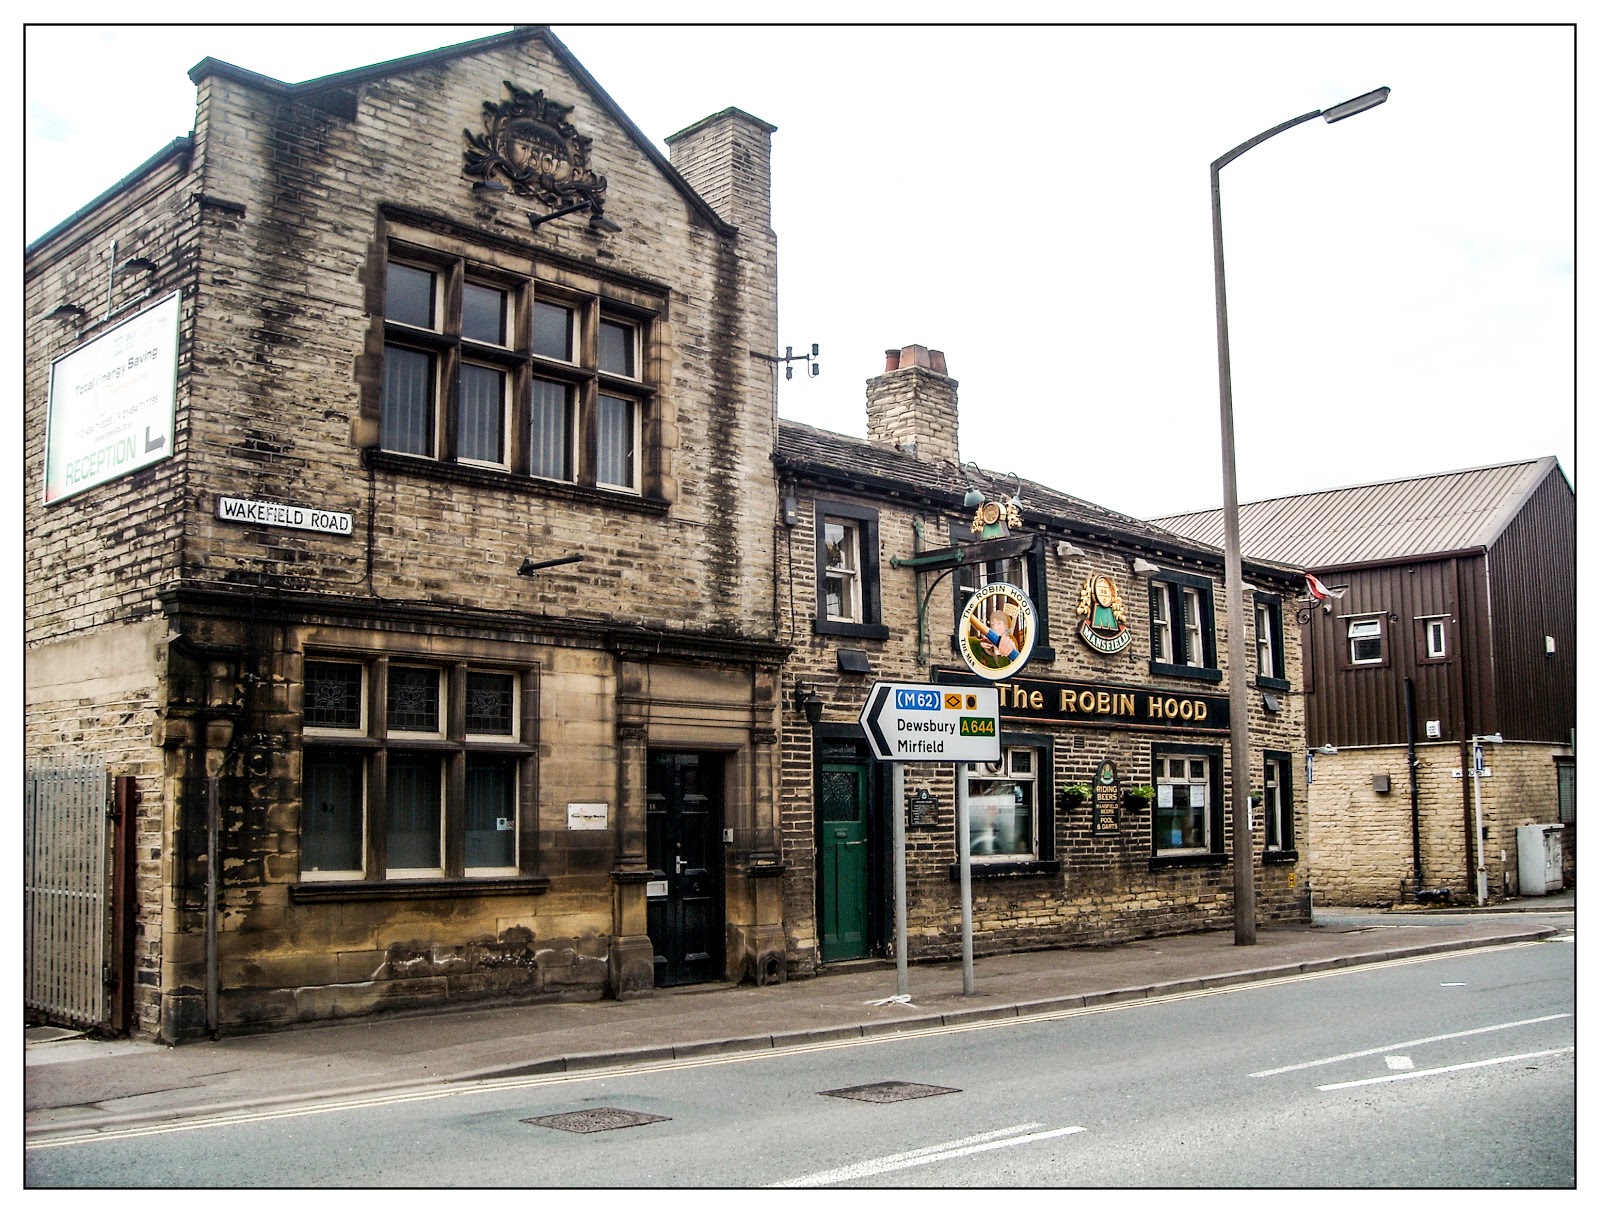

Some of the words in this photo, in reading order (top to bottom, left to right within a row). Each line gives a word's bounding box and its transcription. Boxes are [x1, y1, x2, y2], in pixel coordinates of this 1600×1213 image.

[127, 347, 158, 370] Saving
[65, 434, 137, 487] RECEPTION
[224, 500, 304, 525] WAKEFIELD
[311, 513, 349, 531] ROAD
[962, 603, 975, 619] The
[975, 585, 1006, 601] ROBIN
[1010, 590, 1031, 616] HOOD
[1083, 627, 1130, 652] MANSFIELD
[995, 682, 1044, 710] The
[1059, 689, 1136, 717] ROBIN
[1148, 696, 1208, 721] HOOD
[898, 719, 956, 735] Dewsbury
[898, 740, 944, 753] Mirfield
[1097, 793, 1117, 801] BEERS
